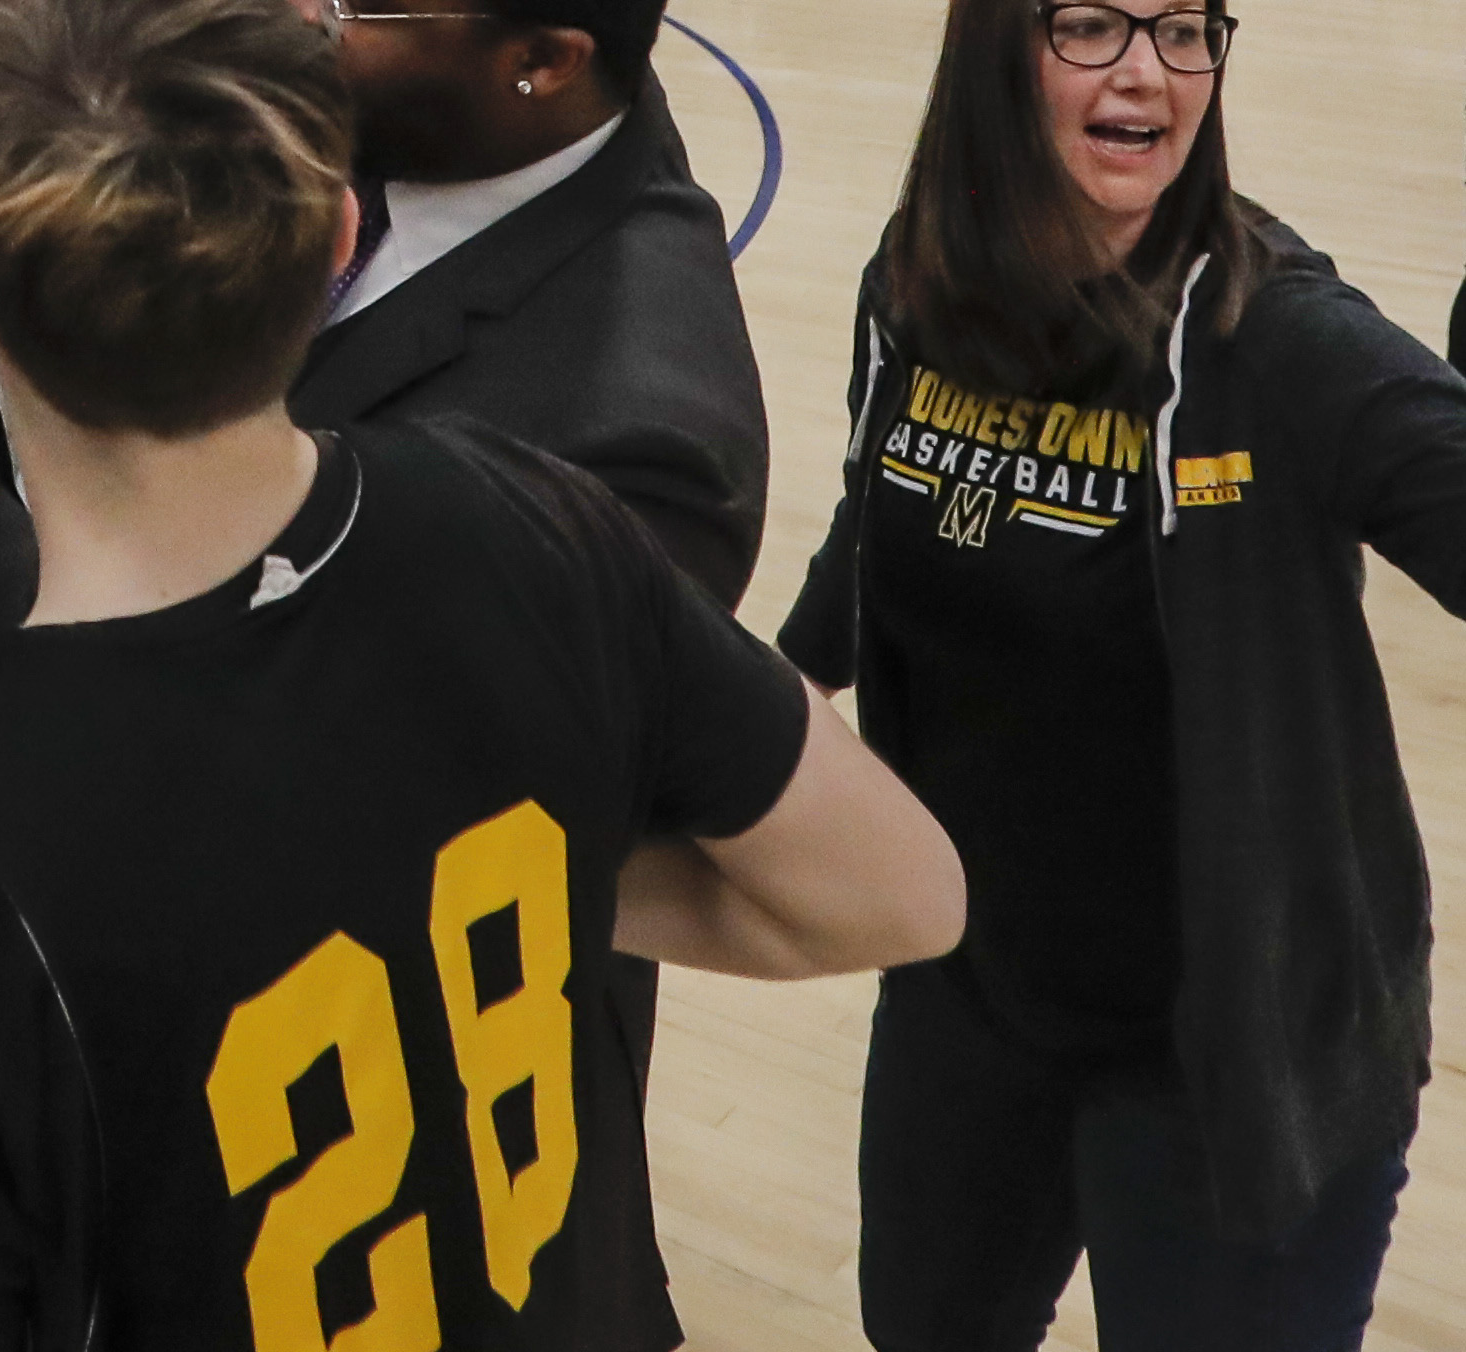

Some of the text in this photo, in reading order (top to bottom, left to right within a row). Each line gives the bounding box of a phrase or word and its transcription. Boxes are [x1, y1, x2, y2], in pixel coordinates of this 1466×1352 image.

[906, 365, 1151, 474] OORESOWN
[938, 481, 997, 548] M
[205, 797, 579, 1352] 28
